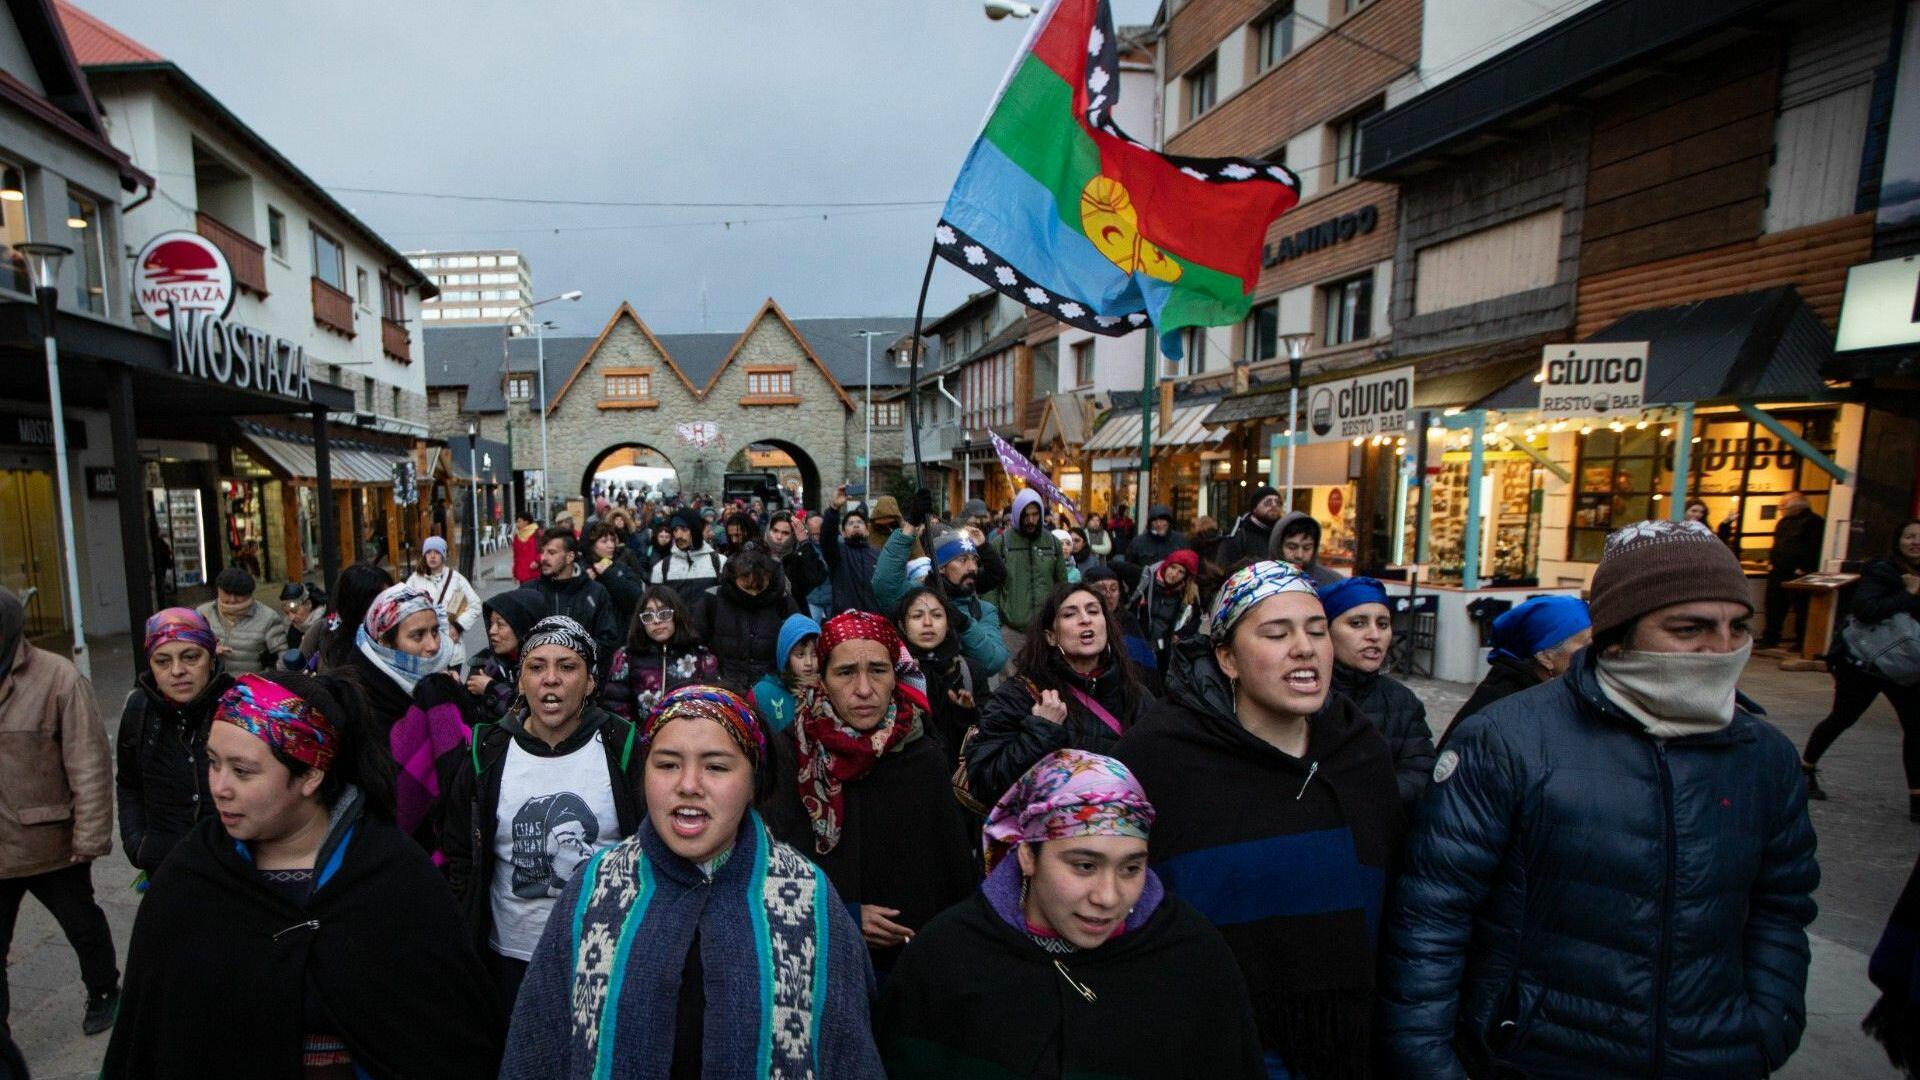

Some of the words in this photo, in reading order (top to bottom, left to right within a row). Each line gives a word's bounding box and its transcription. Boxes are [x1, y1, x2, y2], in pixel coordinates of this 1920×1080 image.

[1262, 204, 1378, 269] LAMINGO
[142, 286, 225, 304] MOSTAZA
[168, 299, 313, 401] MOSTAZA
[1546, 350, 1642, 385] CÍVICO
[1338, 377, 1409, 418] CÍVICO
[1542, 396, 1591, 412] RESTO
[1611, 394, 1640, 410] BAR
[1341, 418, 1374, 437] RESTO
[1379, 414, 1404, 432] BAR
